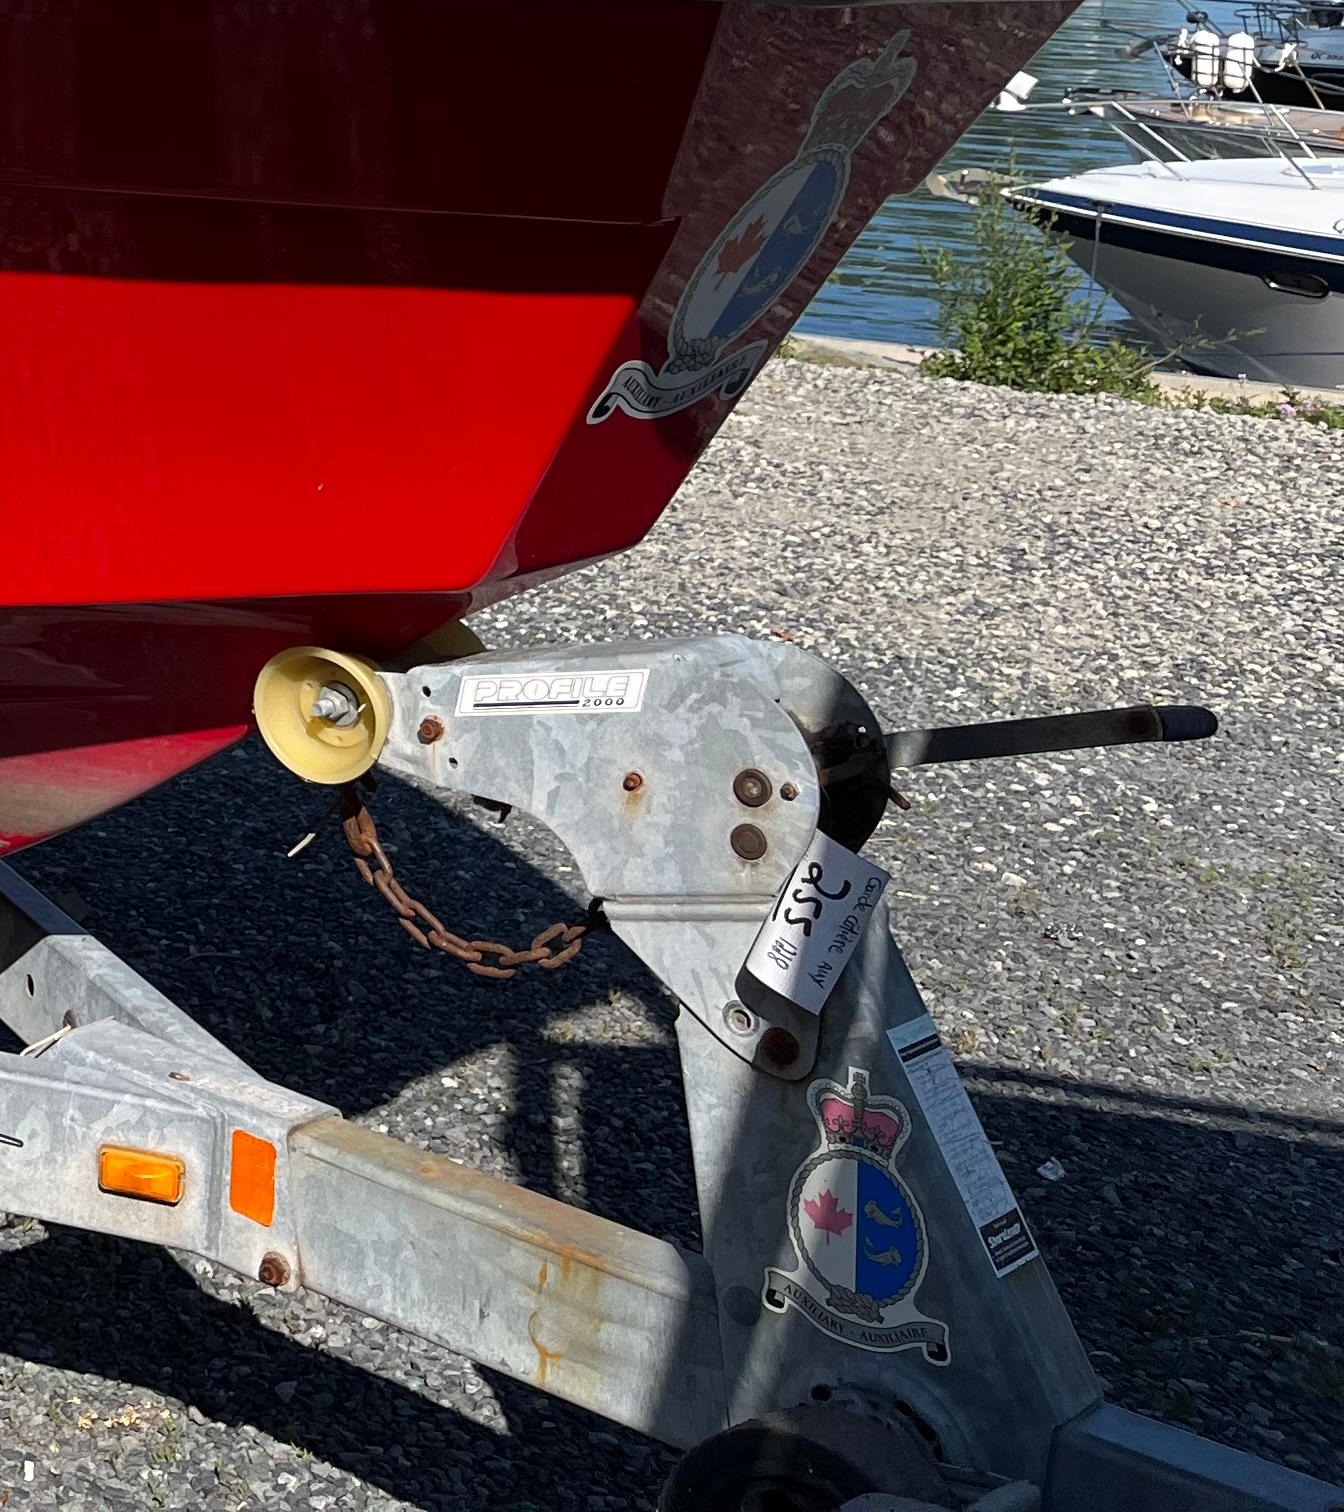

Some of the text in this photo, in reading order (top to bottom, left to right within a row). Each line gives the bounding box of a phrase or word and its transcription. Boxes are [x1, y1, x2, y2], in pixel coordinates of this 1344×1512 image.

[474, 675, 631, 702] PROFILE
[581, 697, 625, 708] 2000
[783, 861, 852, 937] 255
[783, 1284, 929, 1343] AUXILIARY AUXILIAIRE
